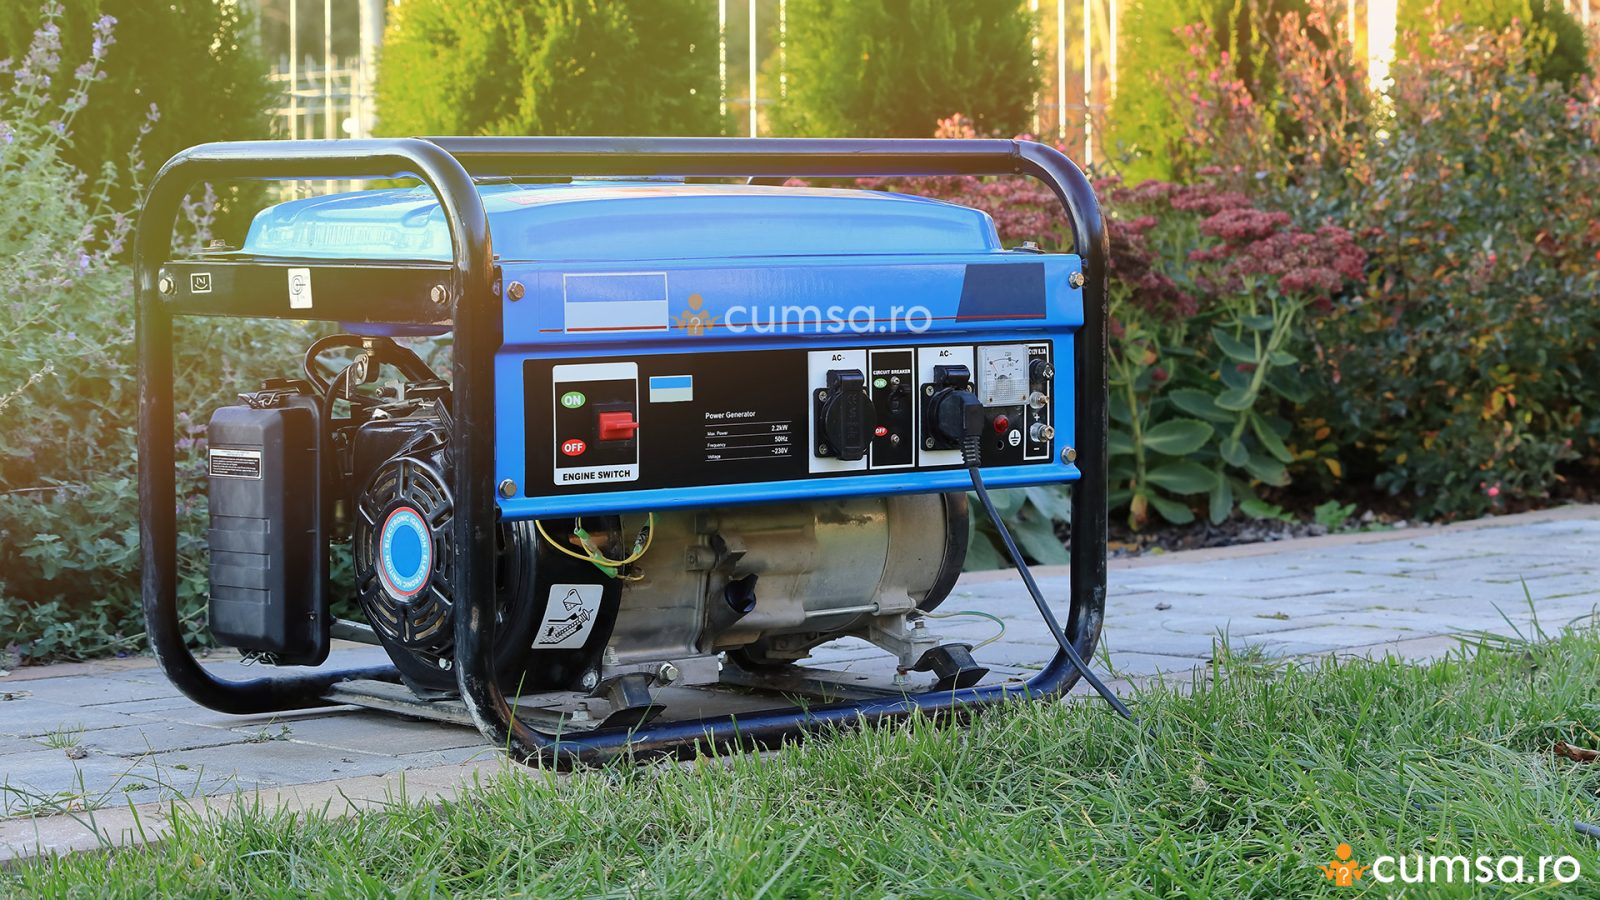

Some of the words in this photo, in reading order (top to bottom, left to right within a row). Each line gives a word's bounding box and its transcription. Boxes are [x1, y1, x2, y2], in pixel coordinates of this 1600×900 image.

[564, 395, 582, 406] ON
[705, 412, 725, 420] Power
[726, 411, 756, 419] Generator
[771, 424, 789, 432] 2.2kW
[875, 427, 886, 435] OFF
[774, 435, 789, 443] 50Hz
[564, 442, 583, 453] OFF
[562, 471, 596, 482] ENGINE
[597, 469, 631, 480] SWITCH
[384, 514, 410, 548] ELECTRONIC
[409, 515, 428, 548] IGNITION
[385, 554, 403, 587] IGNITION
[403, 554, 428, 589] ELECTRONIC
